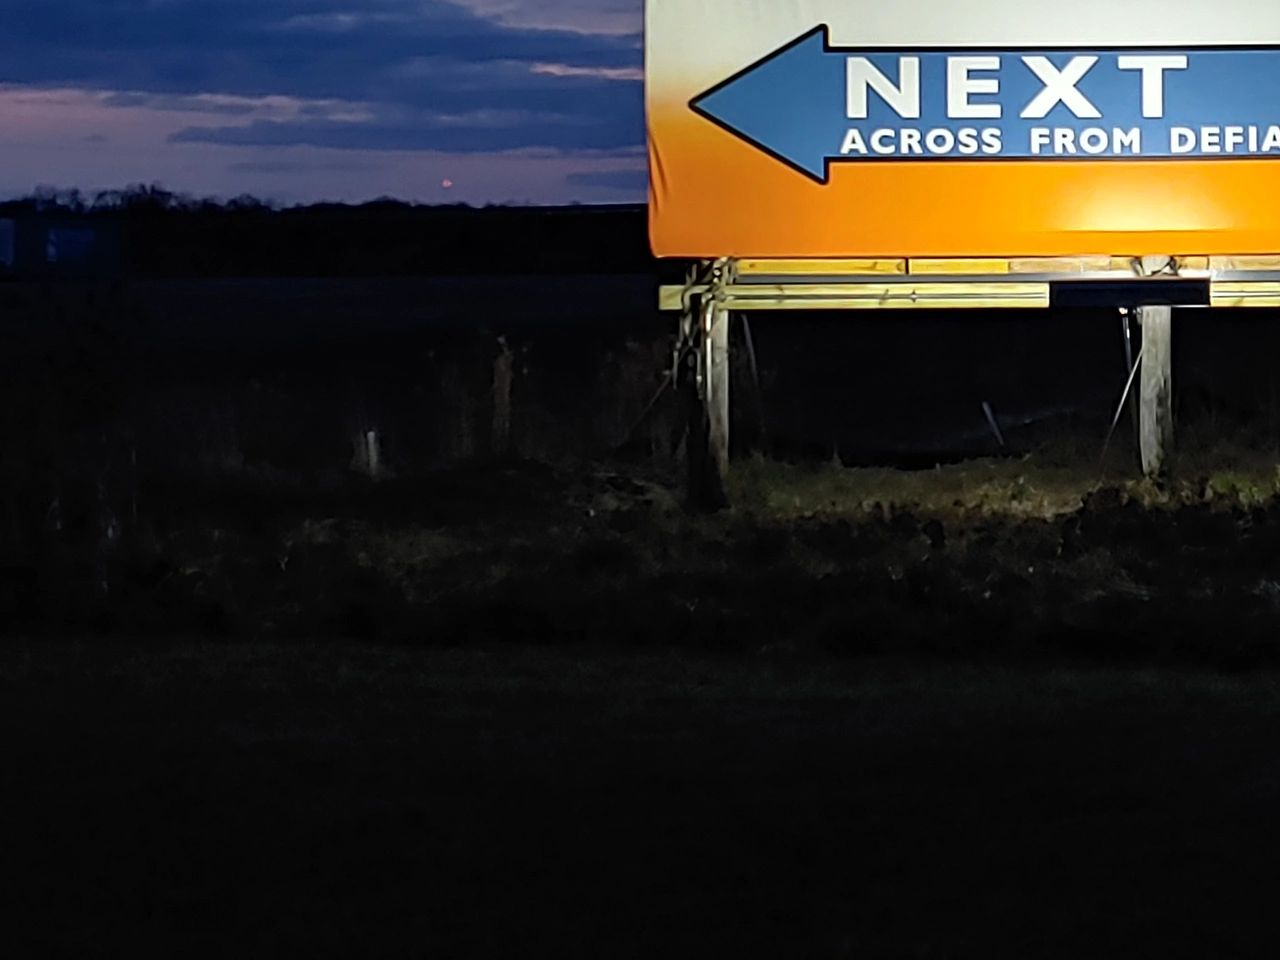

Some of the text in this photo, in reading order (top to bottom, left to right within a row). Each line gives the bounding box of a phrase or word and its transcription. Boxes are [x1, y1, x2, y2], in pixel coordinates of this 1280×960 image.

[846, 54, 1188, 119] NEXT
[840, 126, 1002, 155] ACROSS
[1030, 126, 1141, 154] FROM
